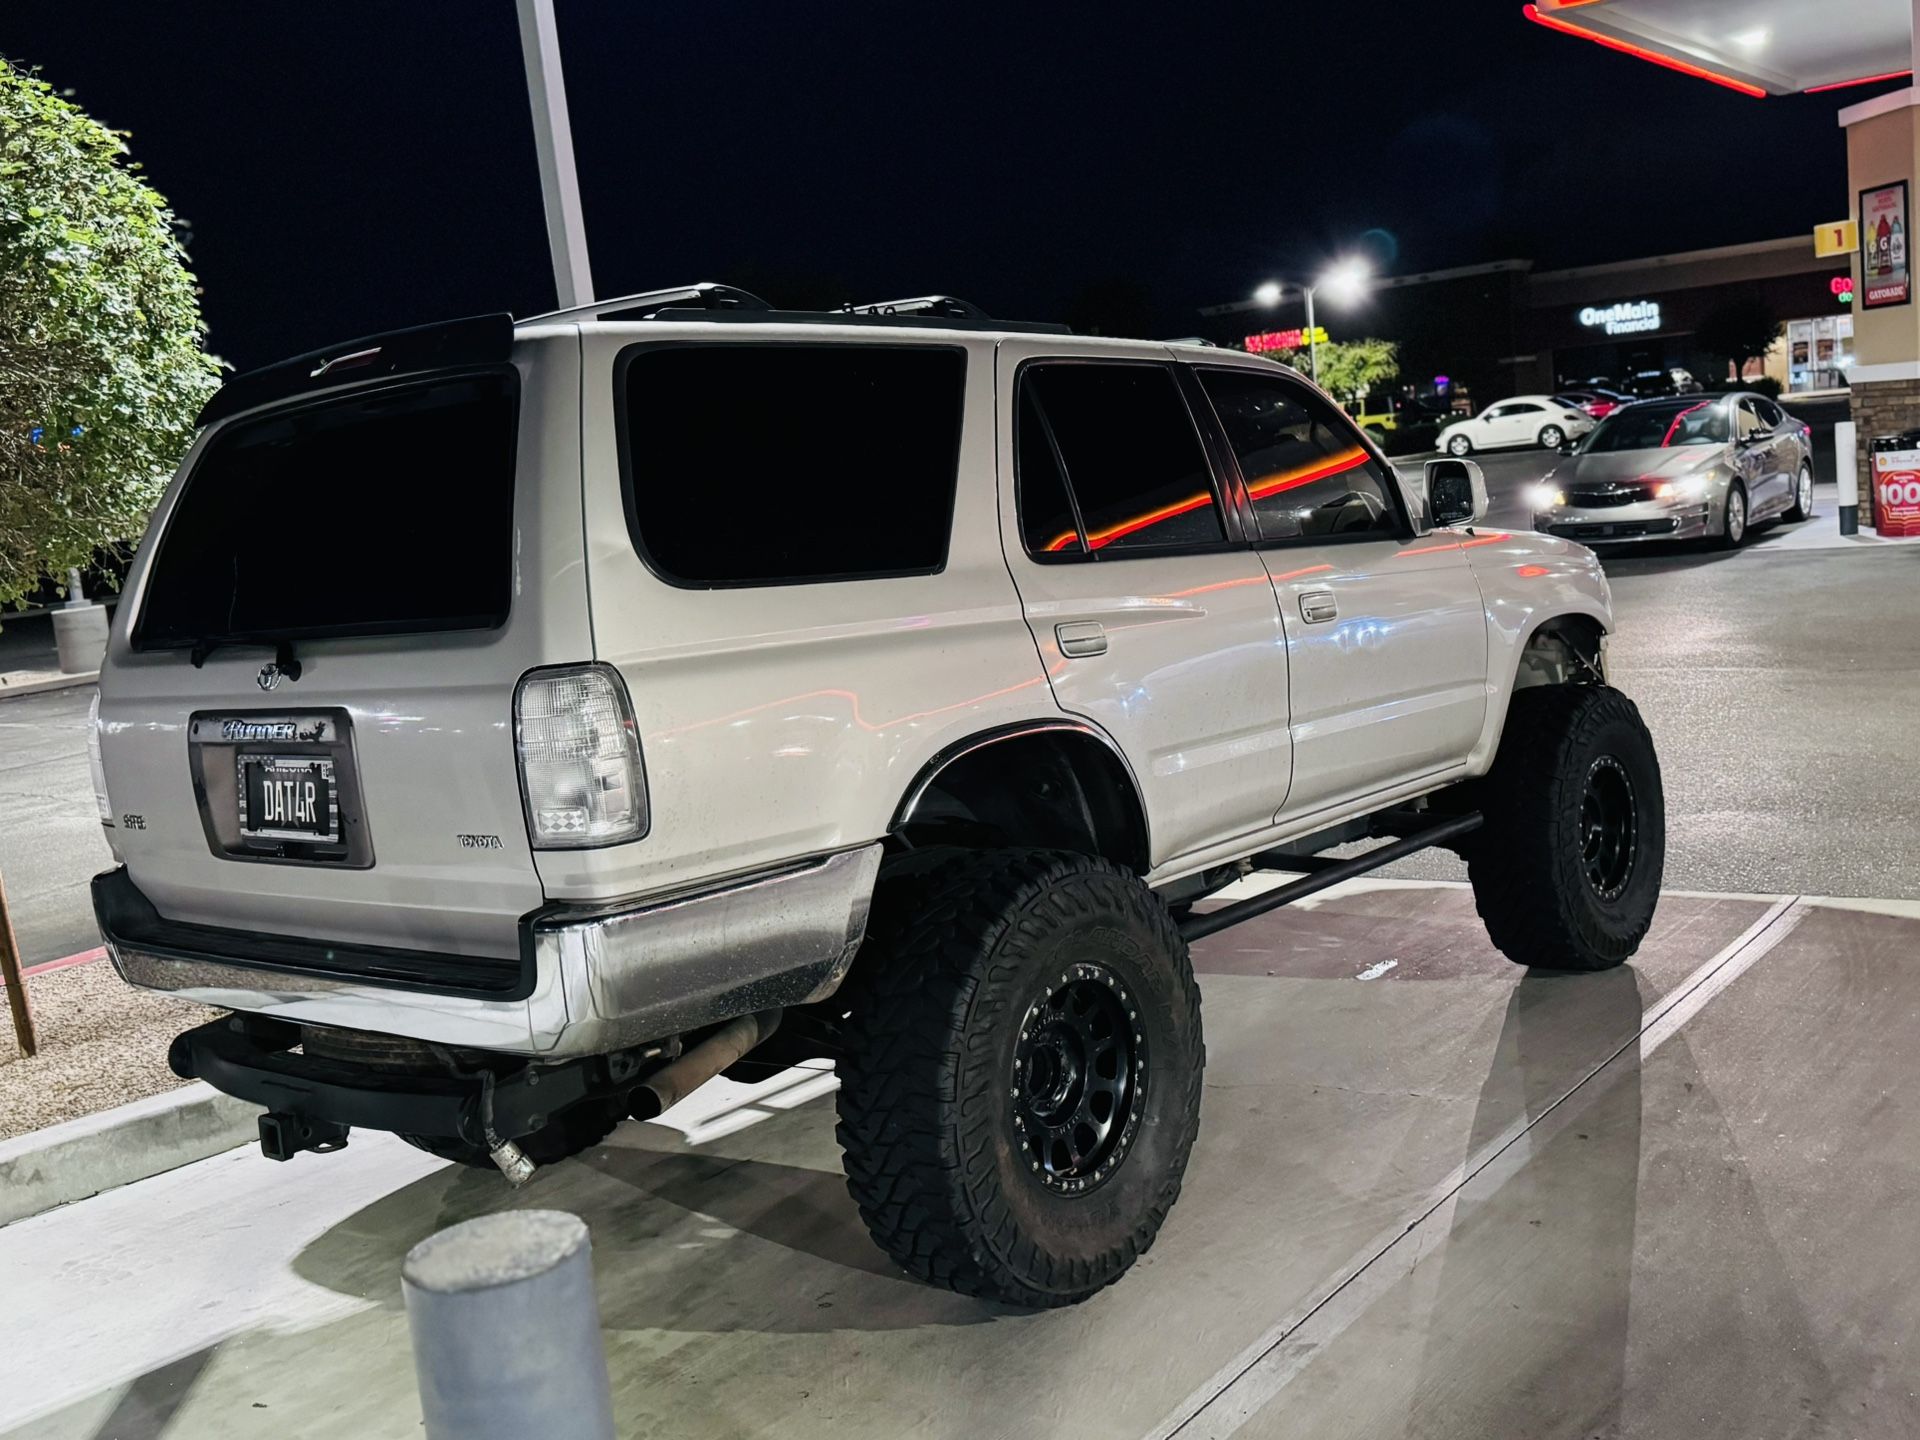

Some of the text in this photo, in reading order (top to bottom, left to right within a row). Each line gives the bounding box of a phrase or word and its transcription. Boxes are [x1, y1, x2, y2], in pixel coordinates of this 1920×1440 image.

[1833, 228, 1843, 248] 1
[1869, 285, 1904, 300] GATORADE
[1580, 301, 1659, 326] OneMain
[1605, 316, 1660, 335] Financial
[262, 780, 317, 823] DAT4R
[456, 834, 505, 850] TOYOTA
